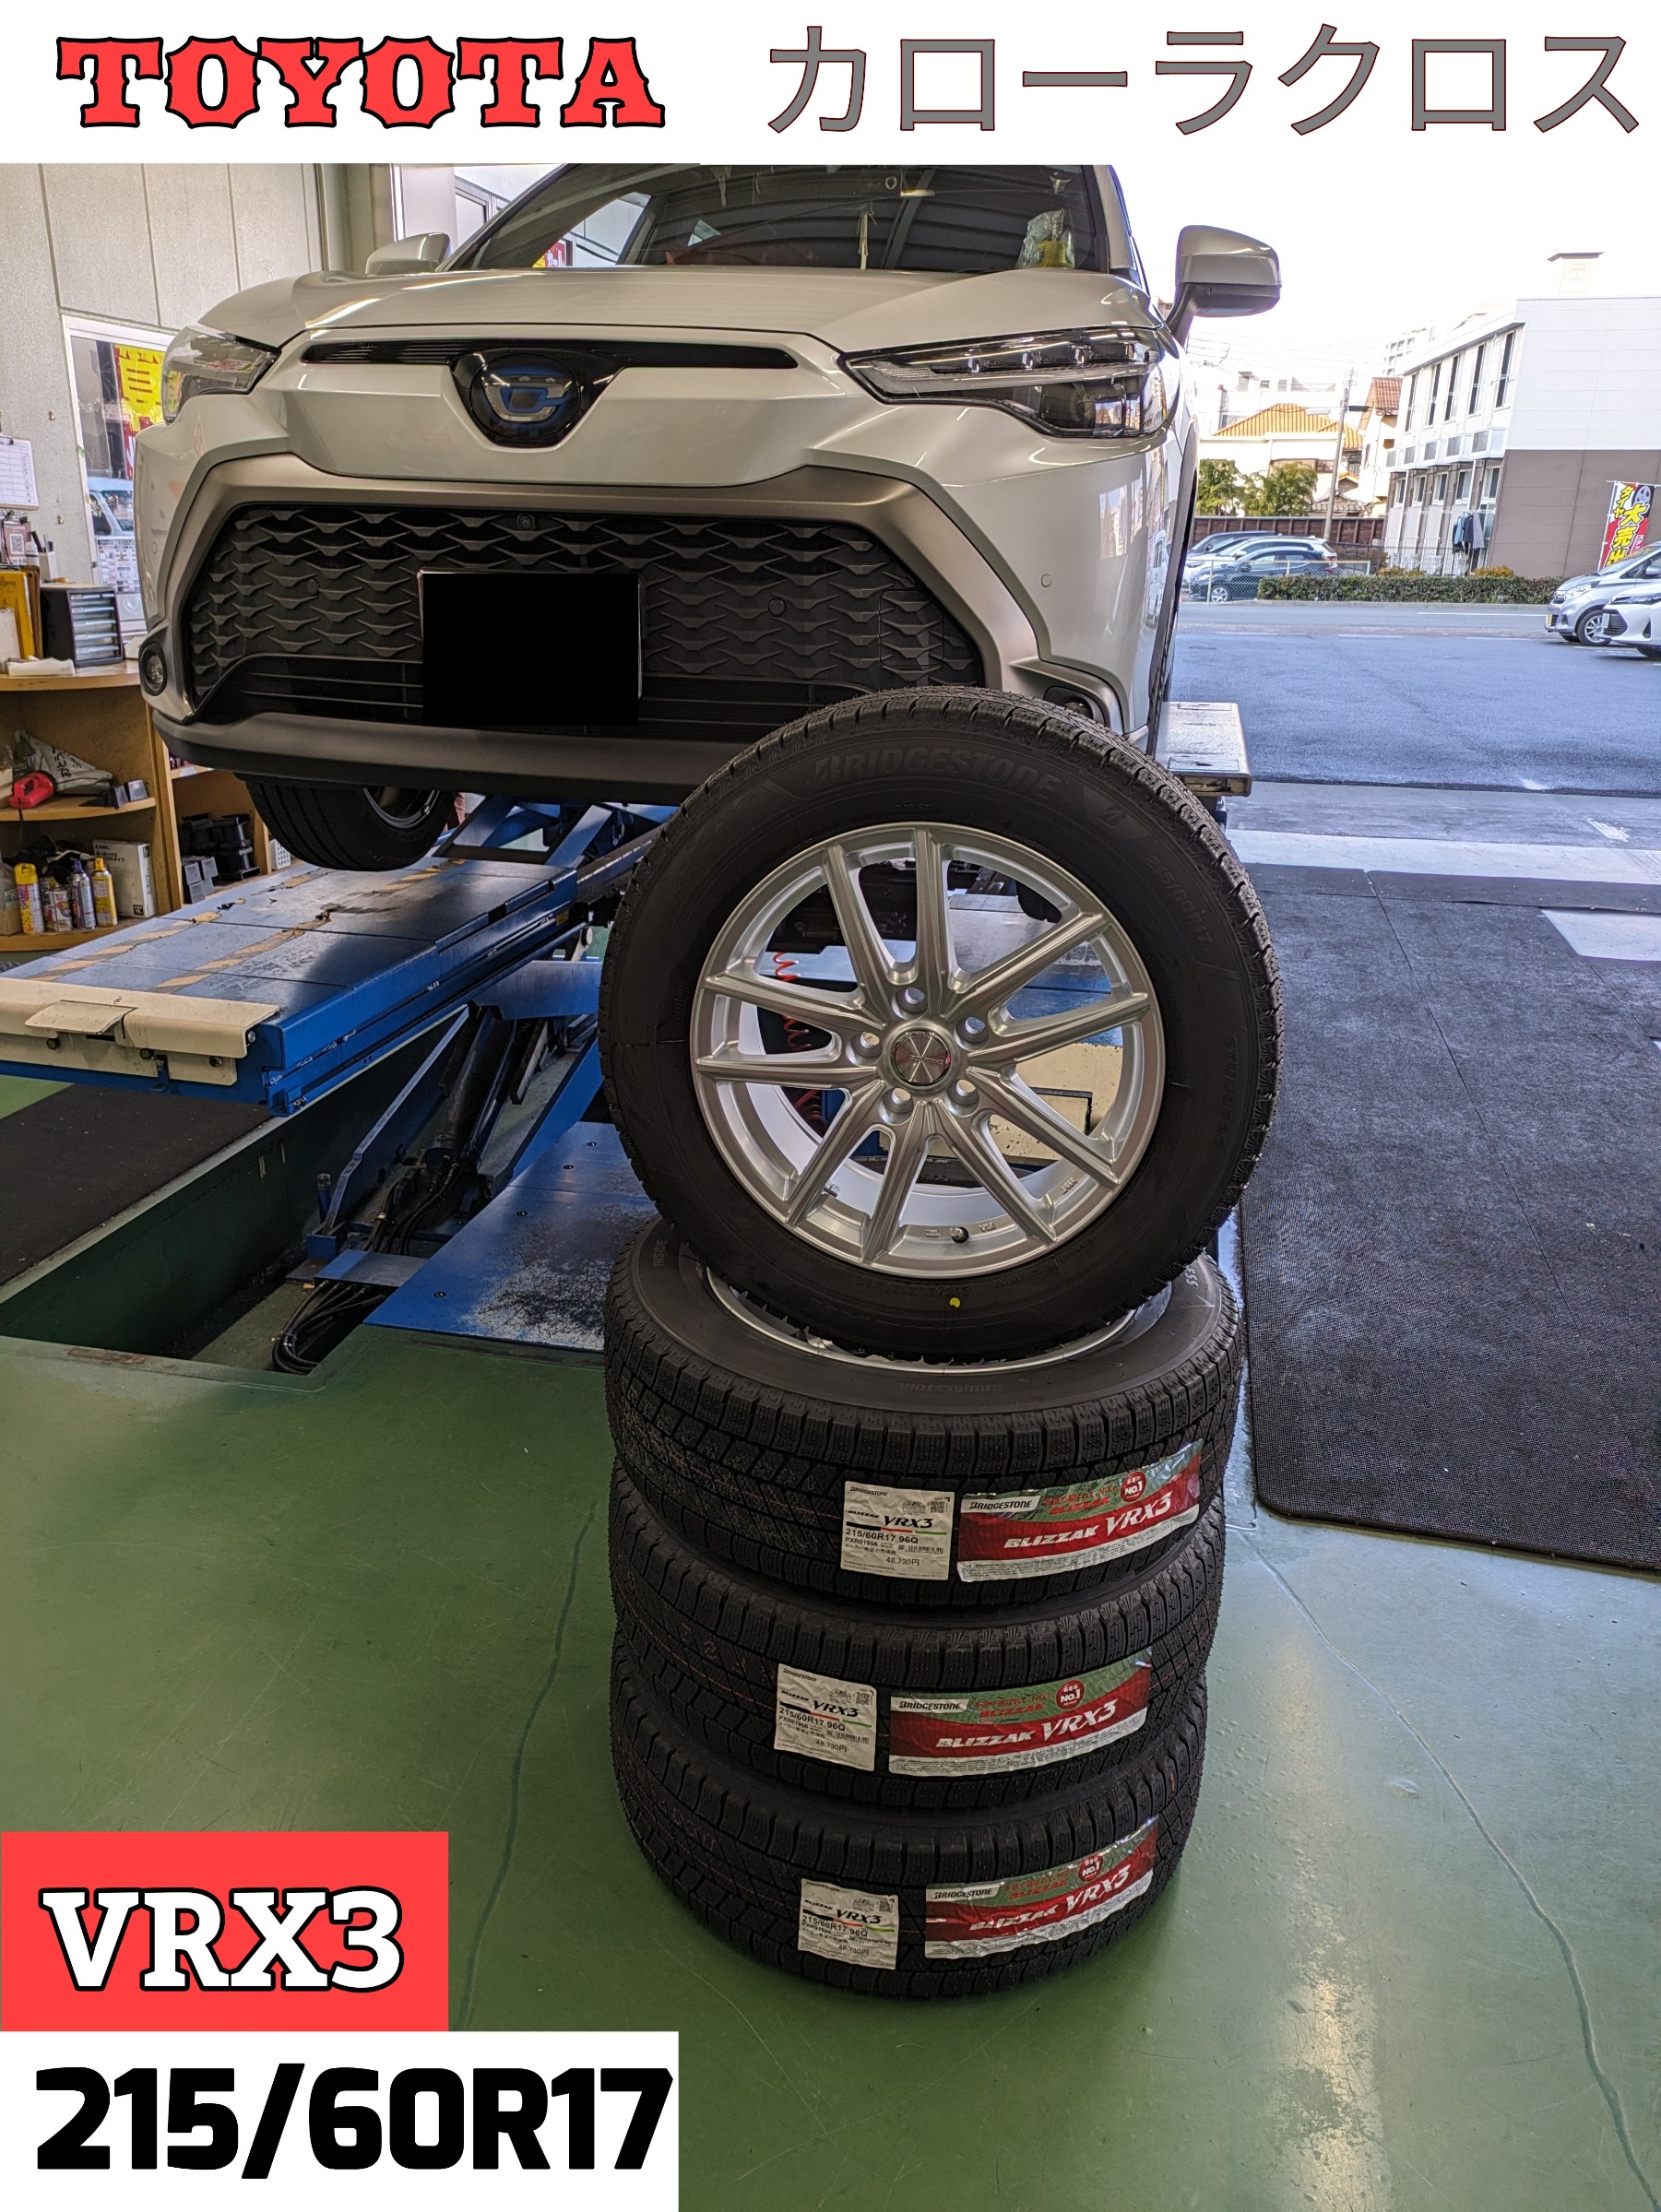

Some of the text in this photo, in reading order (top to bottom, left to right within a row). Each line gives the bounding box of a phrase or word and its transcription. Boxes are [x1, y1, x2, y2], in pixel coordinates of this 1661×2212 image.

[1613, 485, 1634, 519] タイヤ
[815, 747, 1061, 798] BRIDGESTONE
[652, 1238, 669, 1267] INSIDE
[1124, 1481, 1143, 1496] NO.1
[969, 1498, 1032, 1510] BRIDGESTONE
[884, 1516, 934, 1528] VRX3
[1003, 1491, 1174, 1549] BLIZZAK VRX3
[845, 1537, 878, 1546] PXR01956
[846, 1529, 919, 1544] 215/60R17 96Q
[1061, 1688, 1081, 1703] NO.1
[813, 1700, 860, 1717] VRX3
[898, 1700, 961, 1710] BRIDGESTONE
[779, 1708, 825, 1726] 215/60R17
[826, 1721, 846, 1732] 96Q
[936, 1698, 1118, 1748] BLIZZAK VRX3
[1082, 1863, 1099, 1875] NO.1
[933, 1887, 992, 1899] BRIDGESTONE
[969, 1905, 1059, 1931] BLIZZAK
[1065, 1863, 1131, 1913] VRX3
[802, 1915, 848, 1932] 215/60R17
[836, 1909, 883, 1924] VRX3
